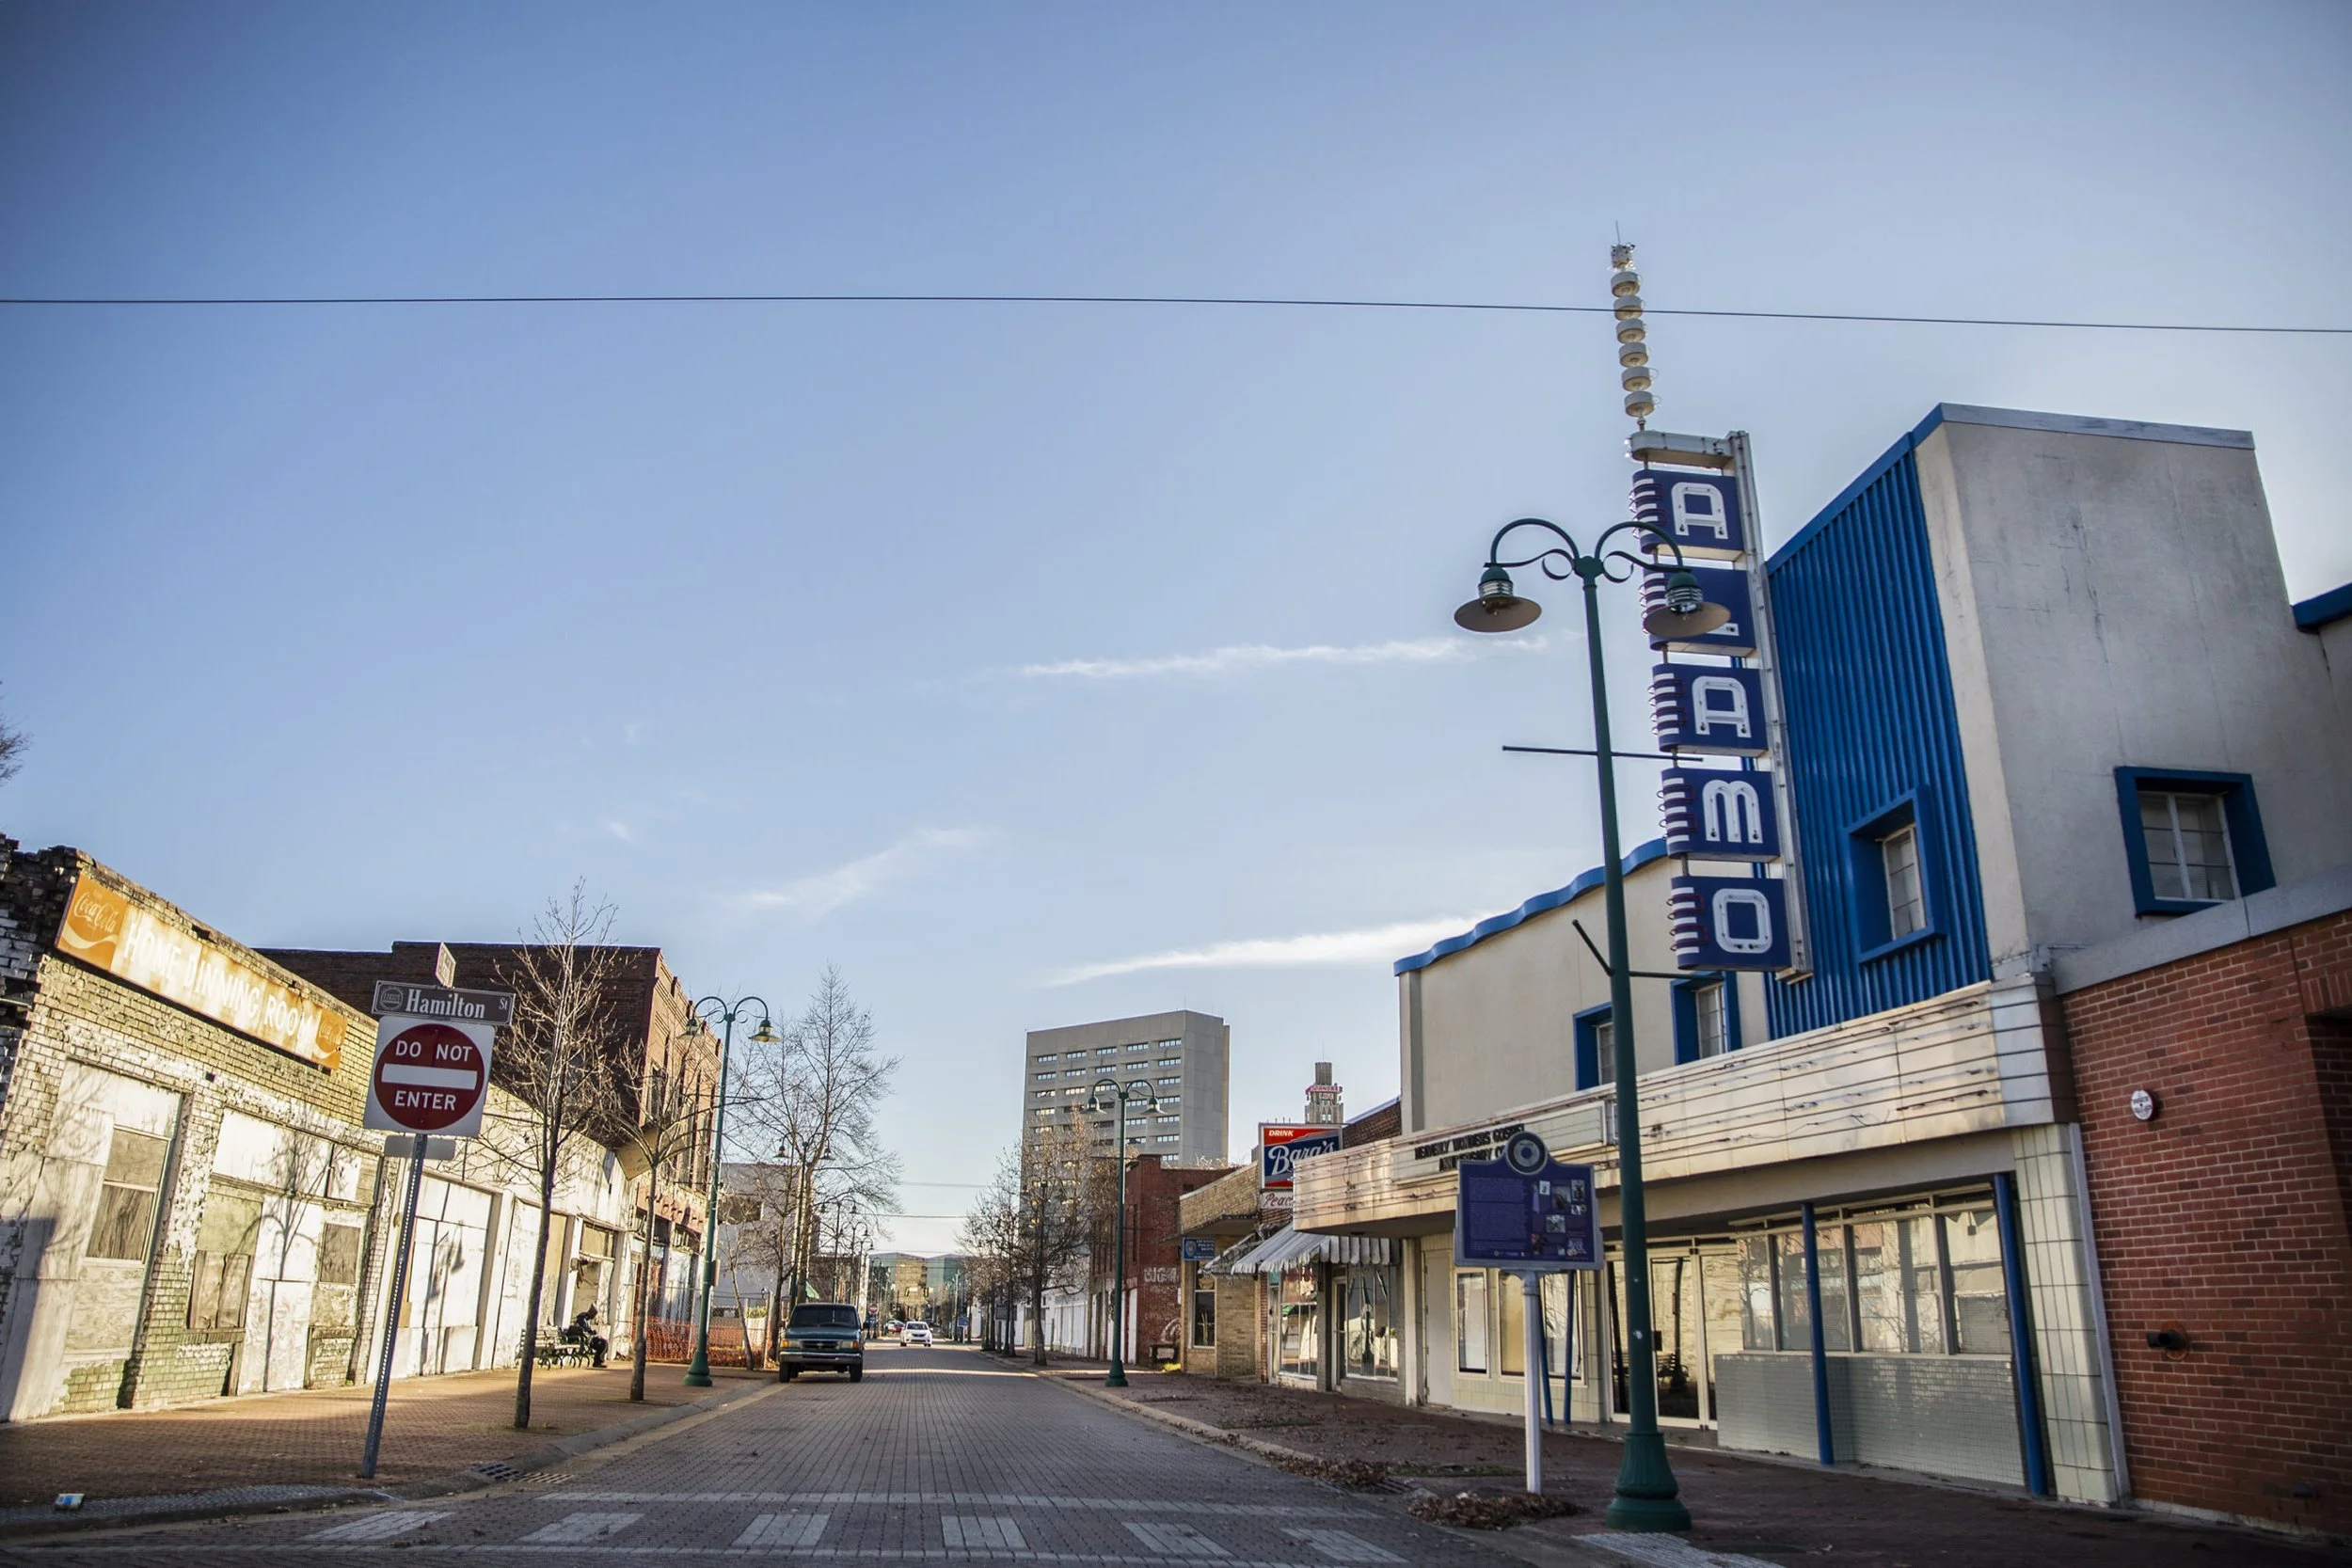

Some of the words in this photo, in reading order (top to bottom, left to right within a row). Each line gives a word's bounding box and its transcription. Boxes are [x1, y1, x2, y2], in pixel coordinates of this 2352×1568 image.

[1671, 481, 1773, 954] AAMO
[123, 922, 182, 981] HOME
[183, 953, 261, 1019] DINNING
[264, 994, 313, 1044] ROOM
[405, 988, 485, 1019] Hamilton
[498, 996, 509, 1010] St
[395, 1039, 421, 1057] DO
[436, 1043, 472, 1061] NOT
[394, 1090, 456, 1111] ENTER
[1268, 1129, 1295, 1137] DRINK
